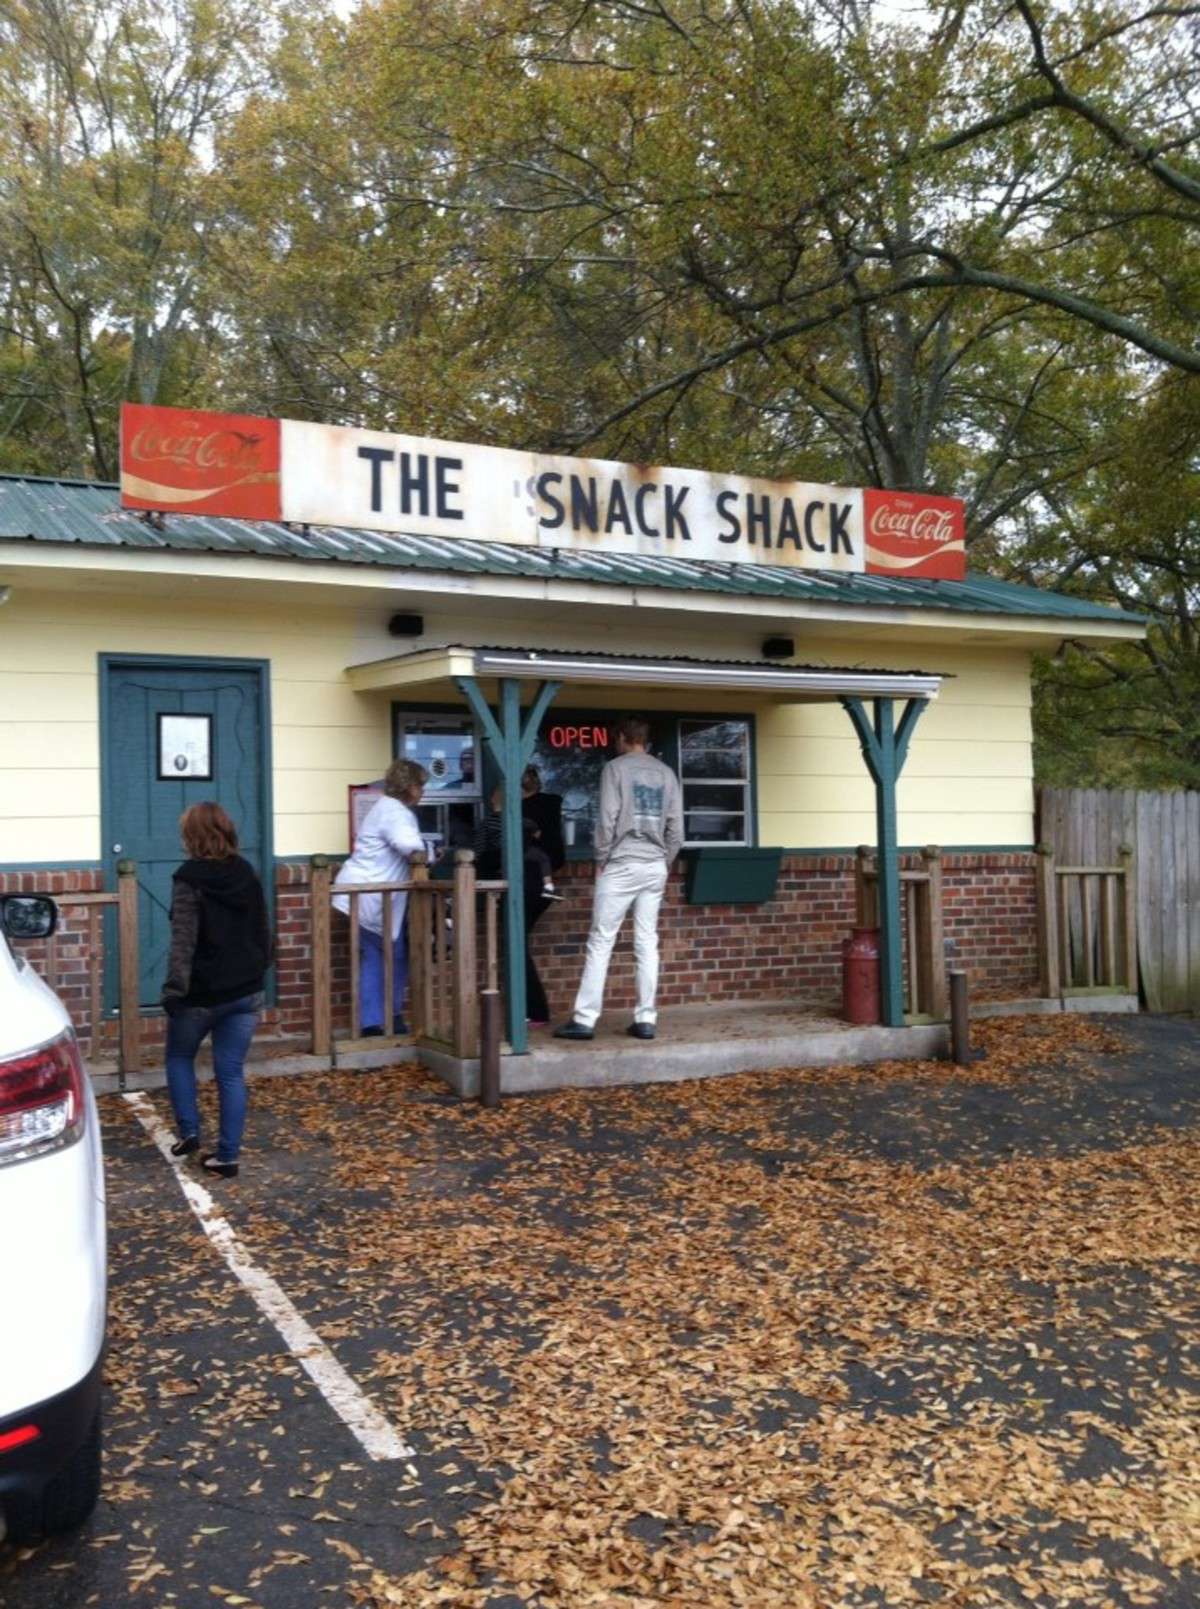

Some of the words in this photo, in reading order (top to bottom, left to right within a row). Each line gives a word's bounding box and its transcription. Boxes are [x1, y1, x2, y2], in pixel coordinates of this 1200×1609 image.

[358, 446, 464, 520] THE
[537, 471, 691, 541] SNACK
[717, 490, 855, 556] SHACK
[870, 504, 955, 541] Coca-Cola
[549, 725, 608, 749] OPEN
